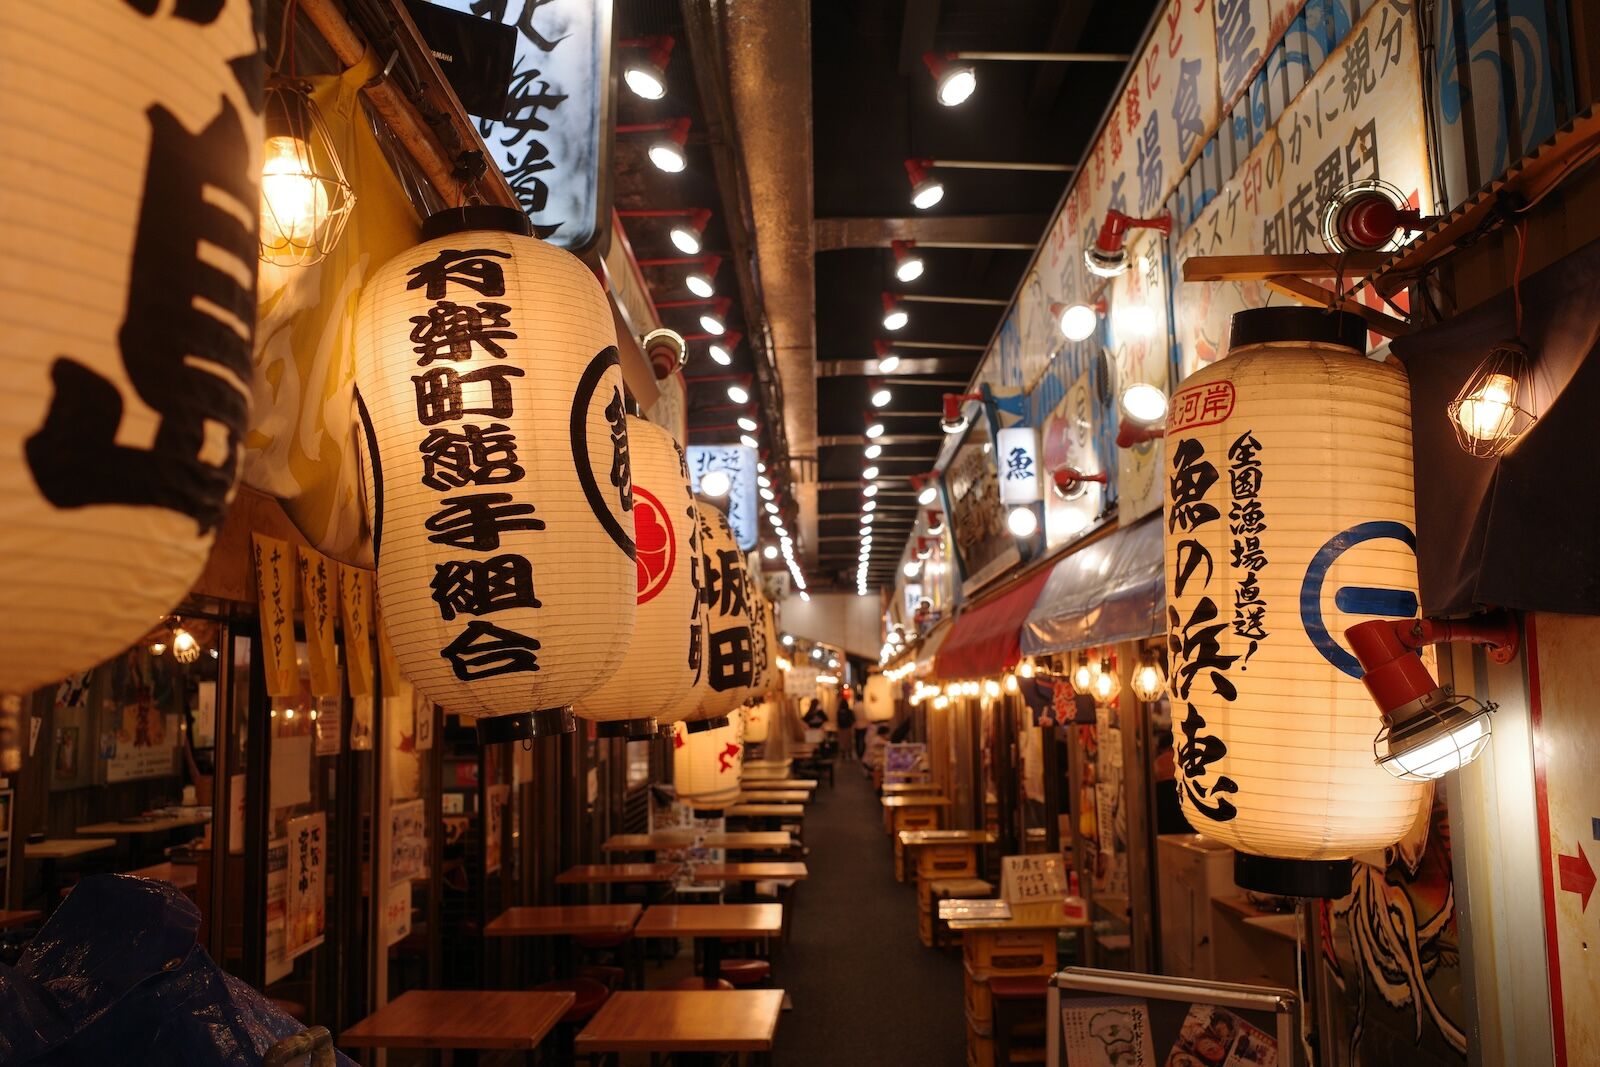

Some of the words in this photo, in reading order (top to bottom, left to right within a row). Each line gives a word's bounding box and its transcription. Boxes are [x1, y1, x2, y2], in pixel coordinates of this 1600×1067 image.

[407, 248, 546, 681] 有楽町熊手組合
[1006, 447, 1034, 481] 魚
[1168, 438, 1242, 822] 魚の浜恵
